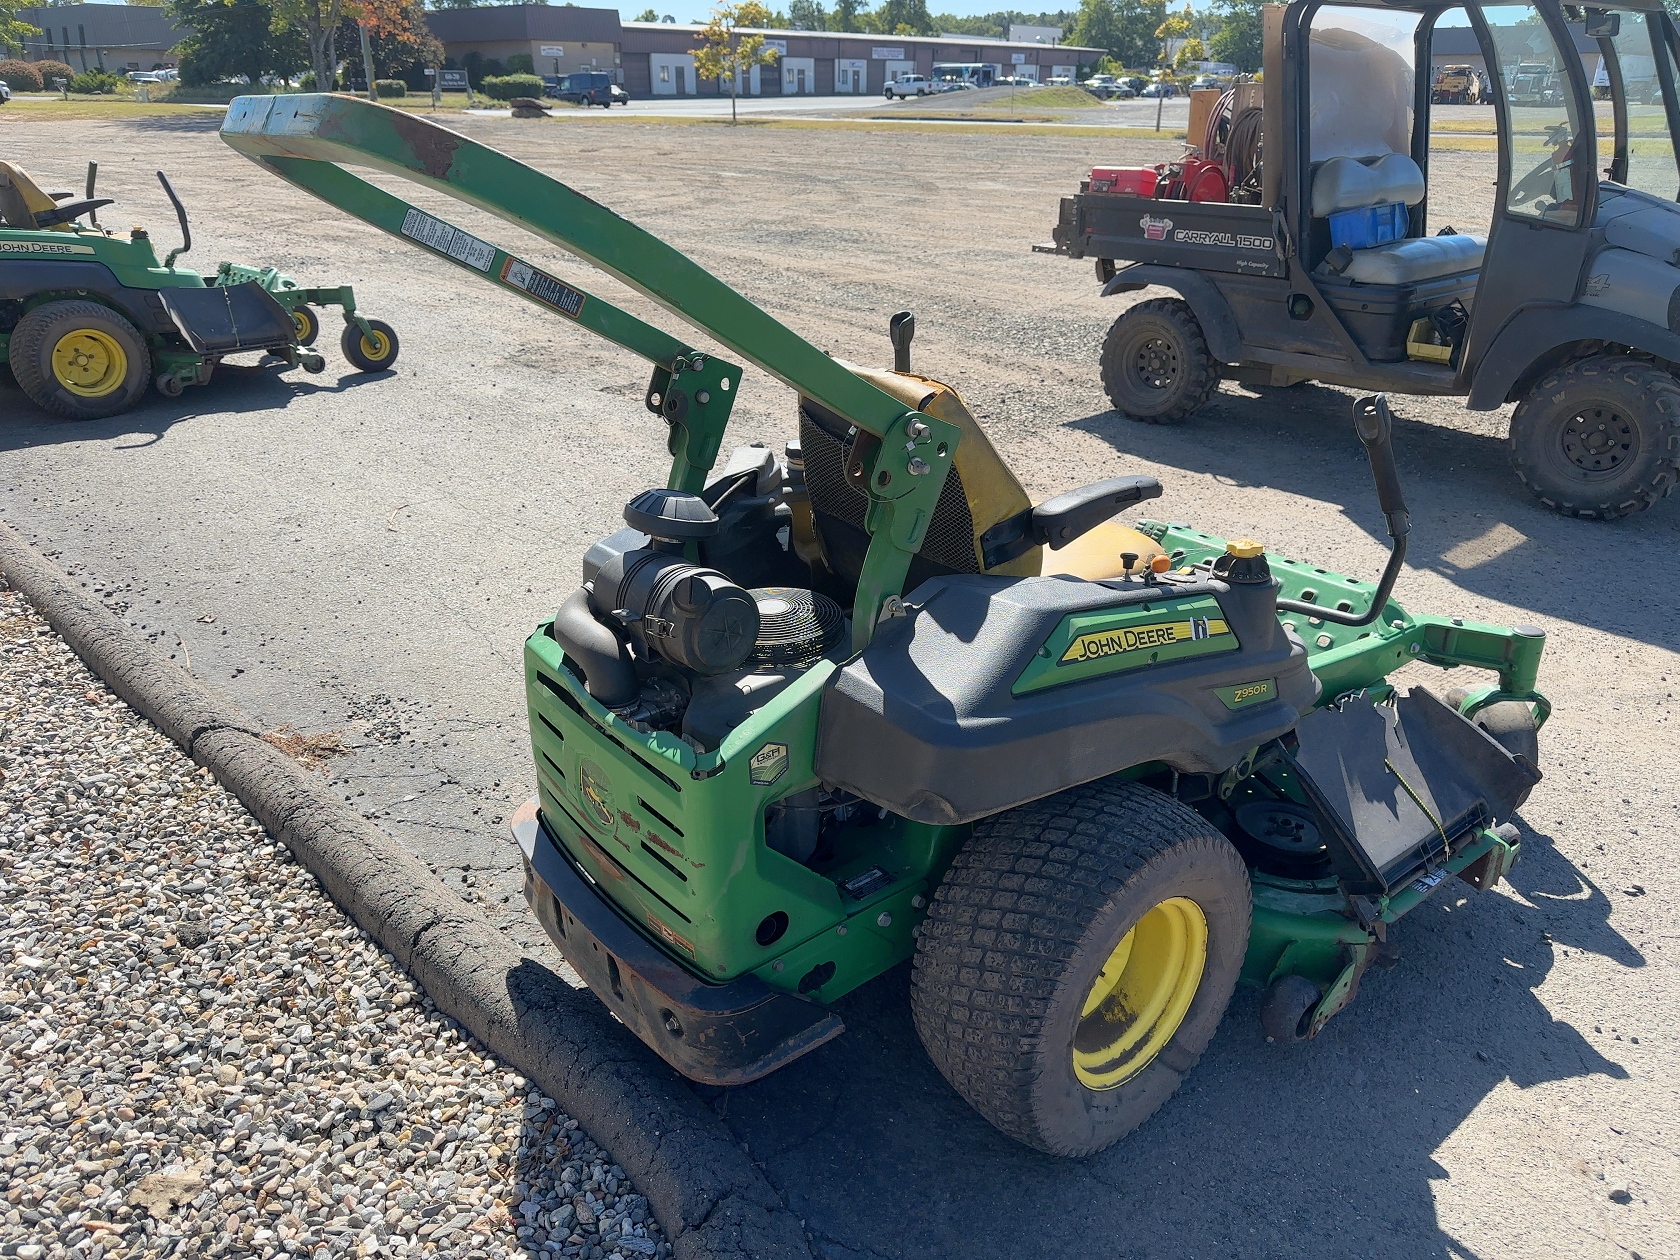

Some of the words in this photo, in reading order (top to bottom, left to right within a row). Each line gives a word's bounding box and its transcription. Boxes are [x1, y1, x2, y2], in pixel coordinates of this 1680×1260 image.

[31, 243, 73, 253] DEERE
[1174, 229, 1235, 246] CARRYALL
[1237, 234, 1274, 250] 1500
[1078, 633, 1123, 658] JOHN
[1123, 627, 1176, 647] DEERE
[1234, 684, 1268, 703] Z950R
